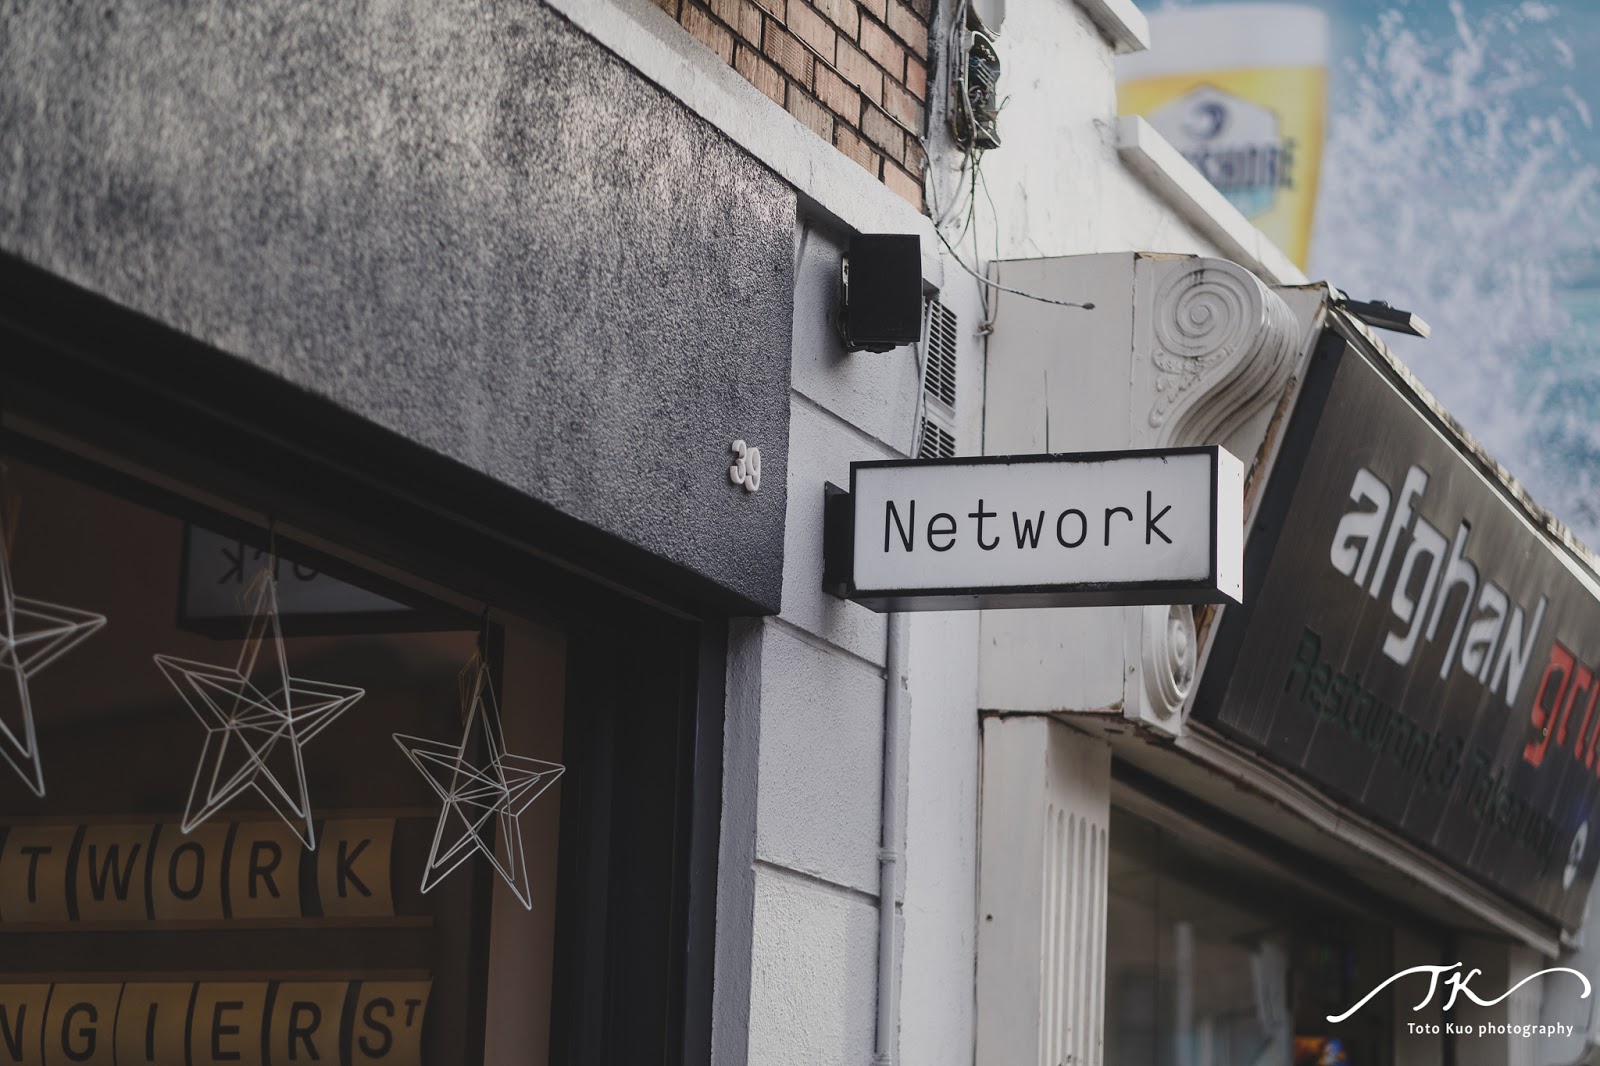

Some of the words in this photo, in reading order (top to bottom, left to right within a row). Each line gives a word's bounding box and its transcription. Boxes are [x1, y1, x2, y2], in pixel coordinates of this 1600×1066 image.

[730, 439, 761, 493] 39
[884, 490, 1174, 554] Network
[20, 838, 372, 903] TWORK
